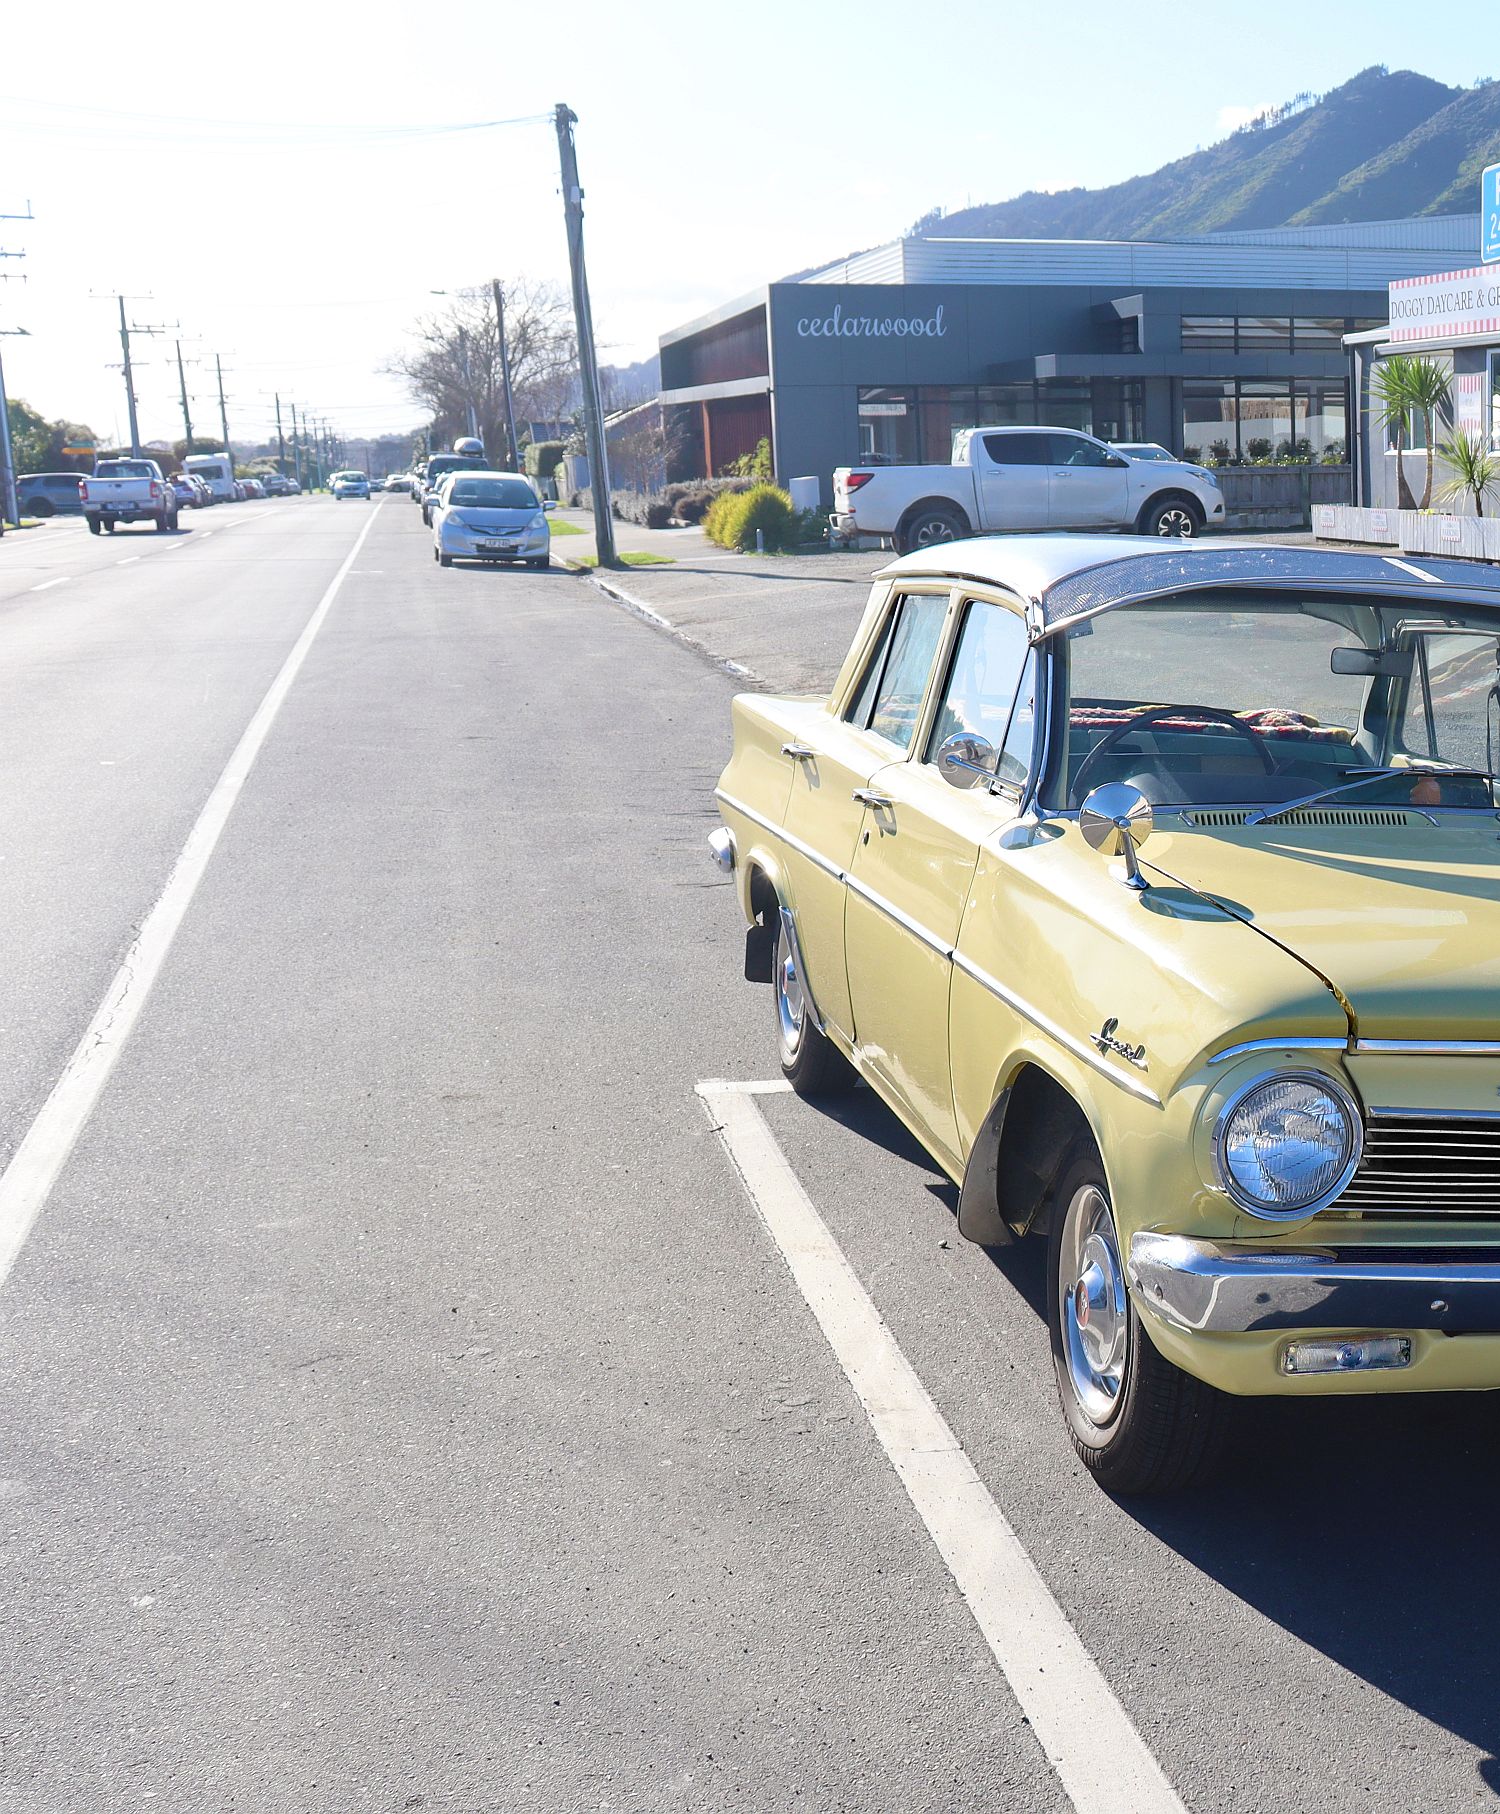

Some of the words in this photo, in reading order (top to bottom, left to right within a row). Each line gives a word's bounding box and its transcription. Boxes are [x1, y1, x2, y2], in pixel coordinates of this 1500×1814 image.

[797, 303, 948, 337] cedarwood
[1391, 297, 1425, 320] DOGGY
[1427, 290, 1473, 314] DAYCARE
[1476, 291, 1485, 308] &
